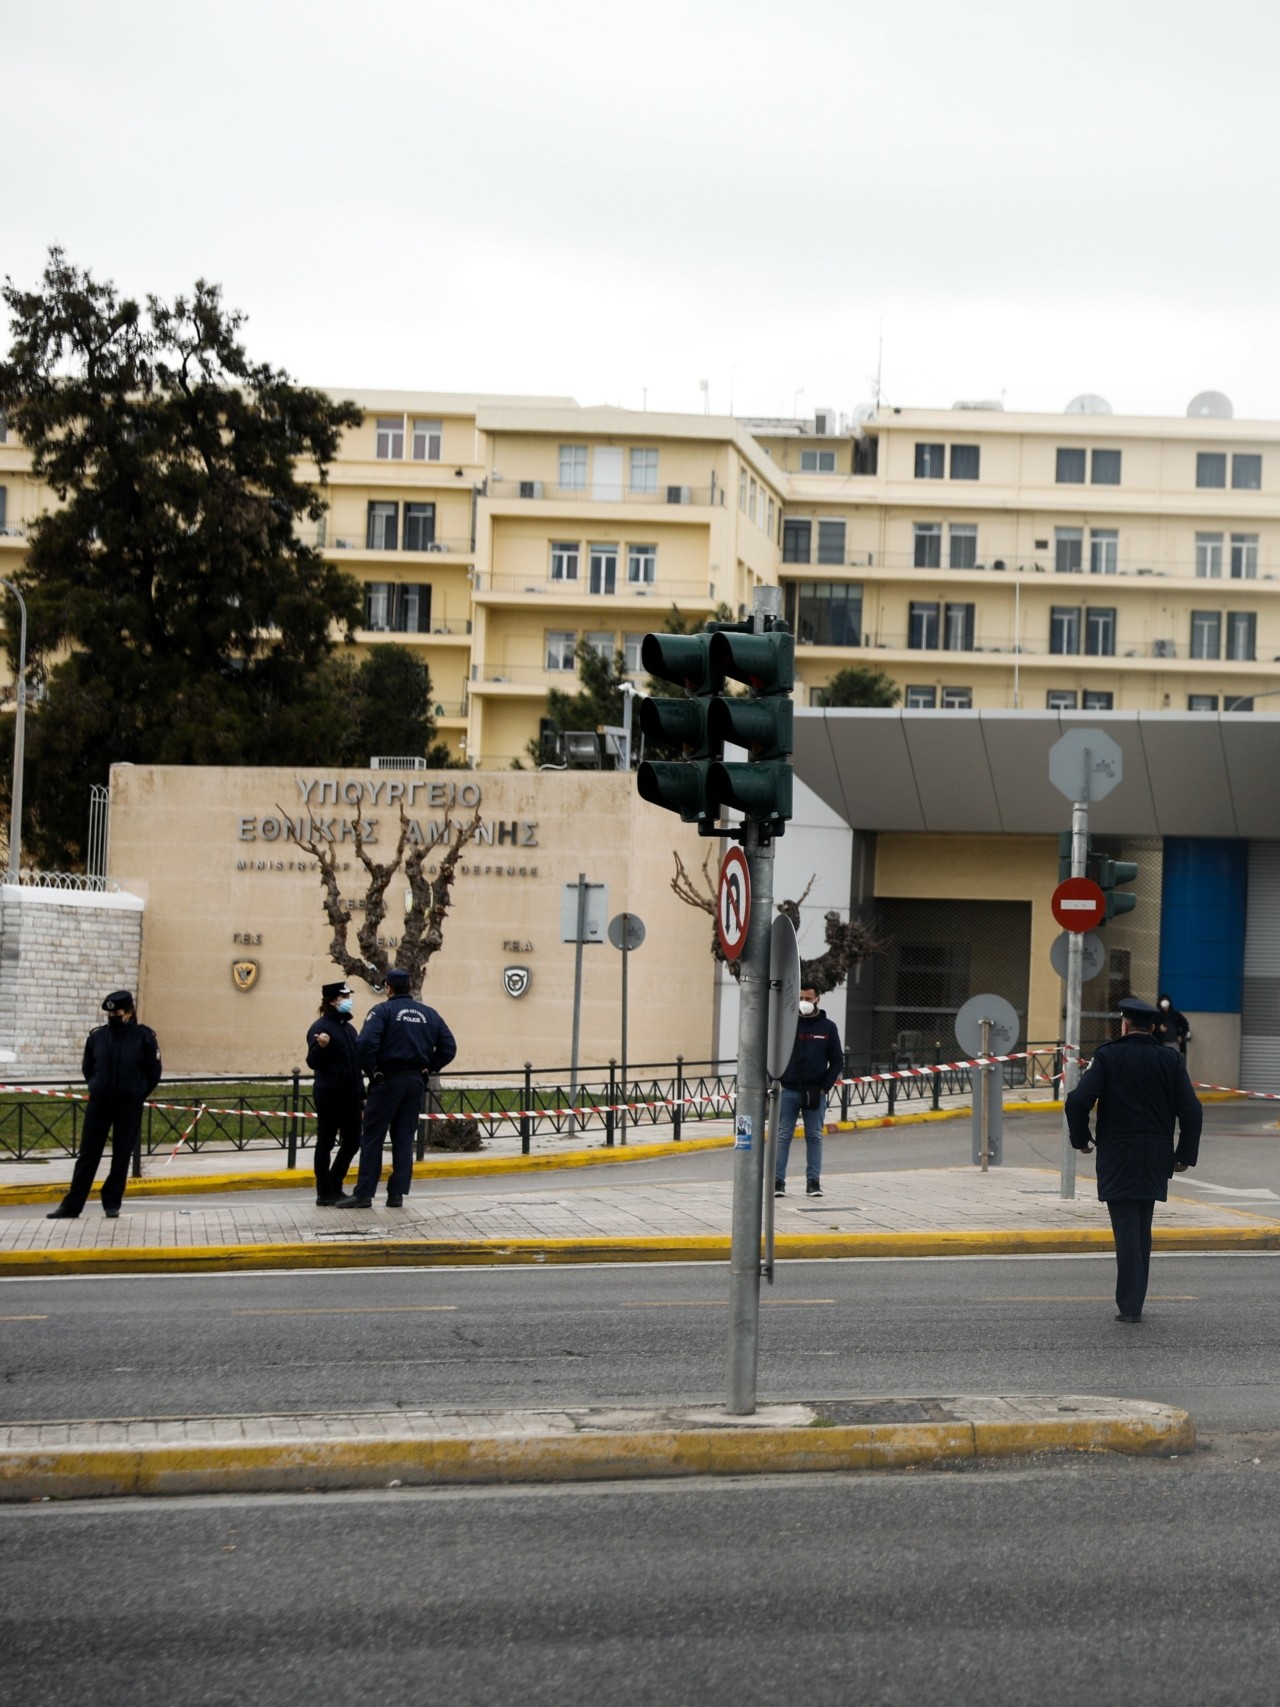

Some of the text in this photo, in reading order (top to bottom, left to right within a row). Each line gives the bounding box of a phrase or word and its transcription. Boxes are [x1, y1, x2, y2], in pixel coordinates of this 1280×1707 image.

[297, 779, 481, 807] ΥΠΟΥΡΓΕΙΟ
[238, 816, 378, 843] ΕΘΝΙΚΗΣ
[461, 865, 539, 877] DEFENCE
